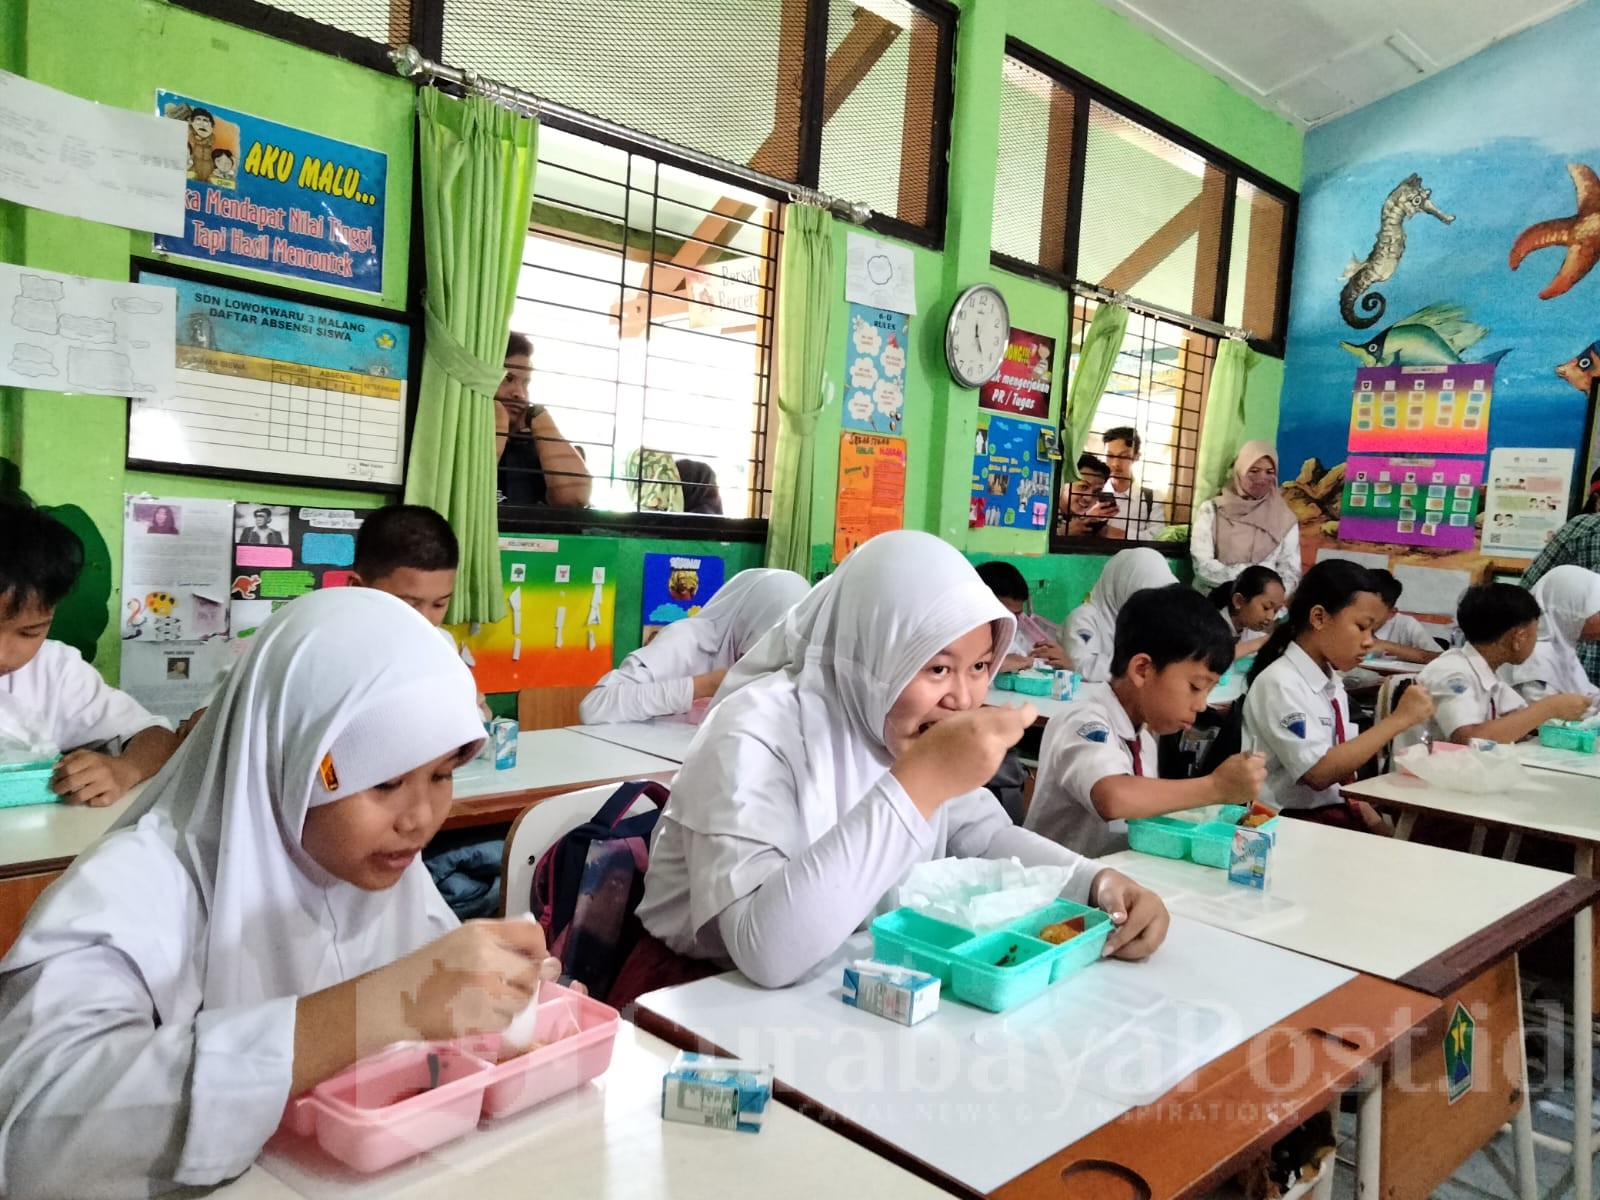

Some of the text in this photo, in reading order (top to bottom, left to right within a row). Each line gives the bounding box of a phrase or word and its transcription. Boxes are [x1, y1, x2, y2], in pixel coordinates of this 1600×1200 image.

[245, 142, 376, 206] AKU MALU...
[206, 188, 286, 230] Mendapat
[289, 208, 323, 238] Nilai
[192, 220, 353, 277] Tapi Hasil Mencontek
[979, 295, 988, 306] 12
[195, 293, 366, 333] SDN LOWOKWARU 3 MALANG
[209, 308, 352, 342] DAFTAR ABSENSI SISWA
[994, 319, 1000, 329] 2
[993, 336, 1000, 346] 3
[959, 359, 965, 369] 7
[967, 366, 973, 377] 6
[978, 364, 984, 374] 5
[1002, 374, 1050, 393] mengerjakan
[992, 388, 1005, 404] PR
[1012, 392, 1036, 410] Tugas
